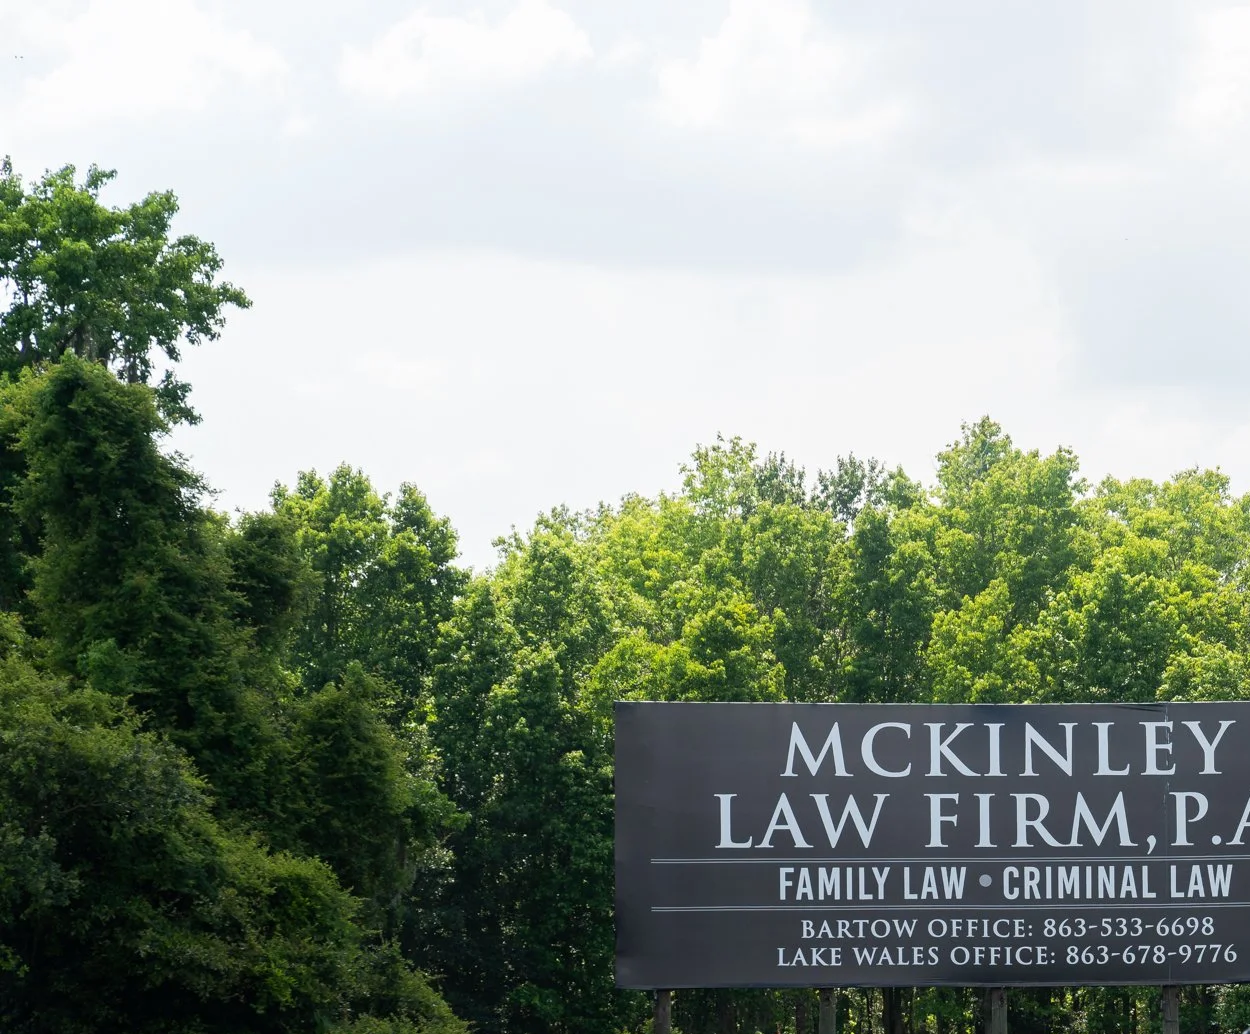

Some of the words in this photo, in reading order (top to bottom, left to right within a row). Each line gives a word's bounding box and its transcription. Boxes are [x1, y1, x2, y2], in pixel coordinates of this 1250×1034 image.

[779, 719, 1237, 778] MCKINLEY
[713, 792, 891, 849] LAW
[779, 866, 891, 901] FAMILY
[903, 866, 967, 900] LAW
[1002, 865, 1157, 900] CRIMINAL
[1170, 863, 1233, 898] LAW
[800, 918, 919, 939] BARTOW
[927, 918, 1033, 938] OFFICE:
[1043, 916, 1215, 938] 863-533-6698
[776, 947, 842, 967] LAKE
[851, 946, 939, 966] WALES
[950, 946, 1055, 966] OFFICE:
[1066, 943, 1238, 965] 863-678-9776
